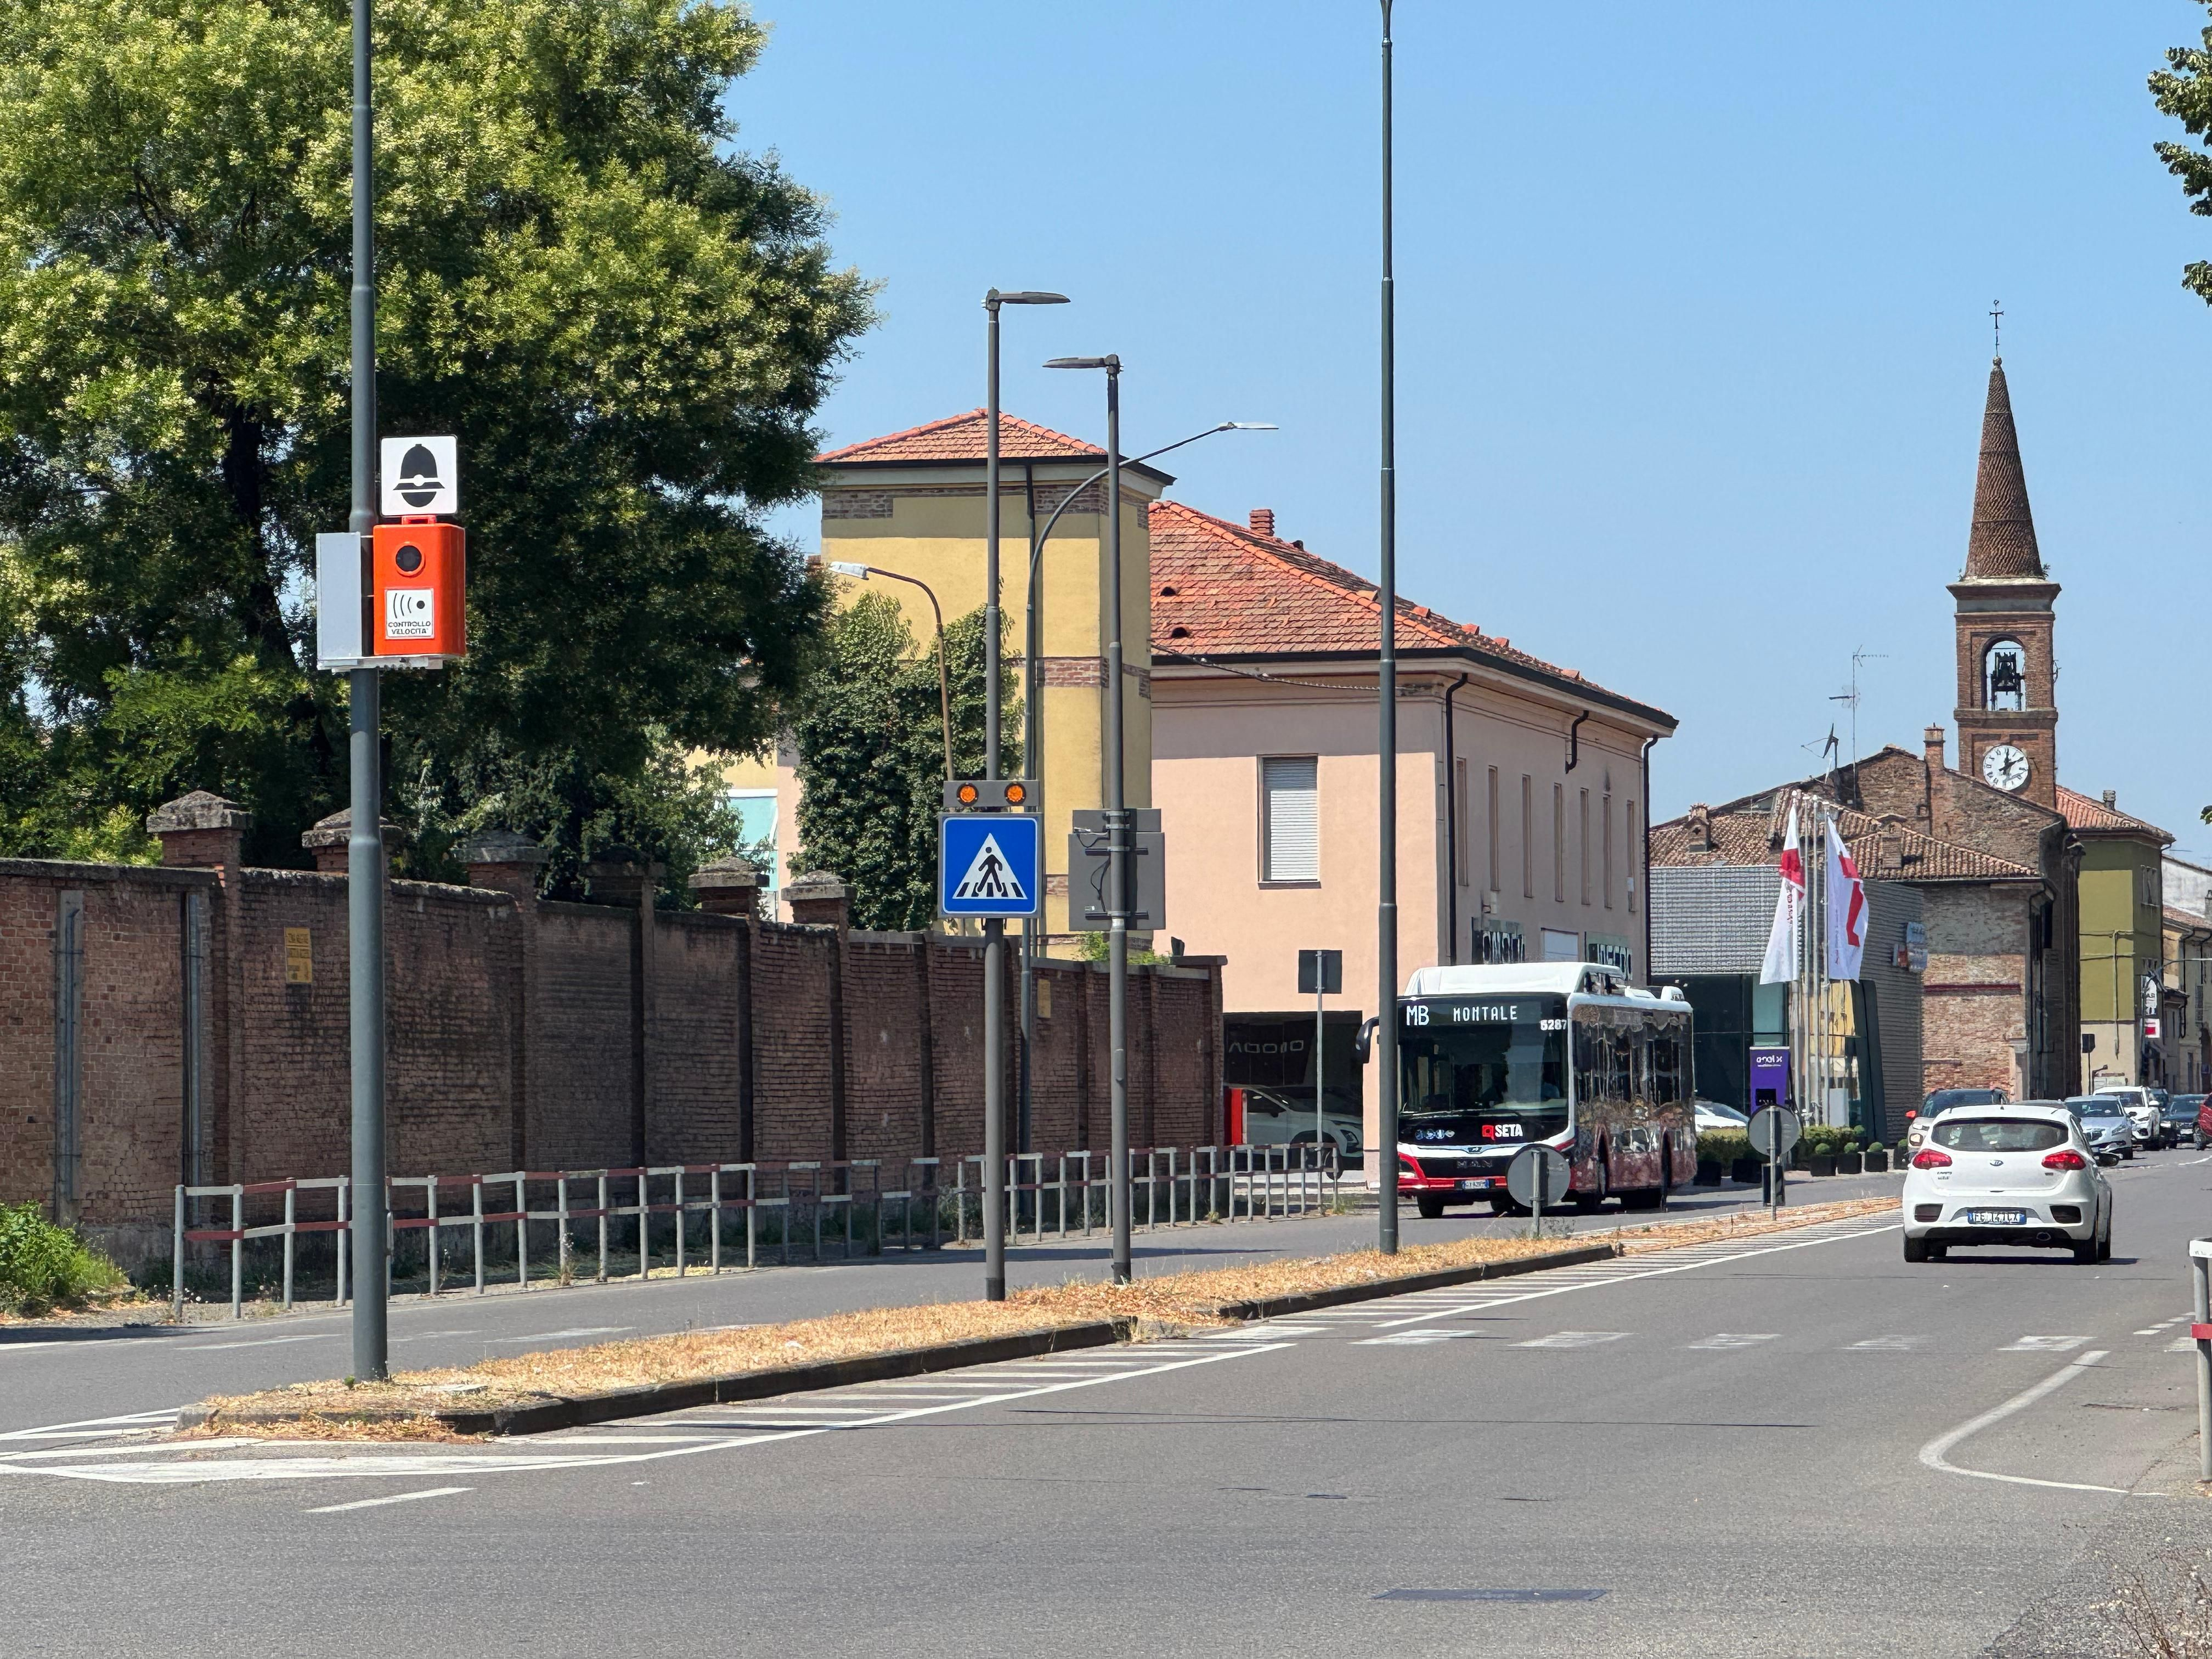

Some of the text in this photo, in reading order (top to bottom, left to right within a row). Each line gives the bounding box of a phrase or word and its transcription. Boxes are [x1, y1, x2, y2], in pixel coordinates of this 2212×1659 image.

[1406, 1005, 1518, 1025] MB MONTALE
[1495, 1124, 1523, 1137] SETA
